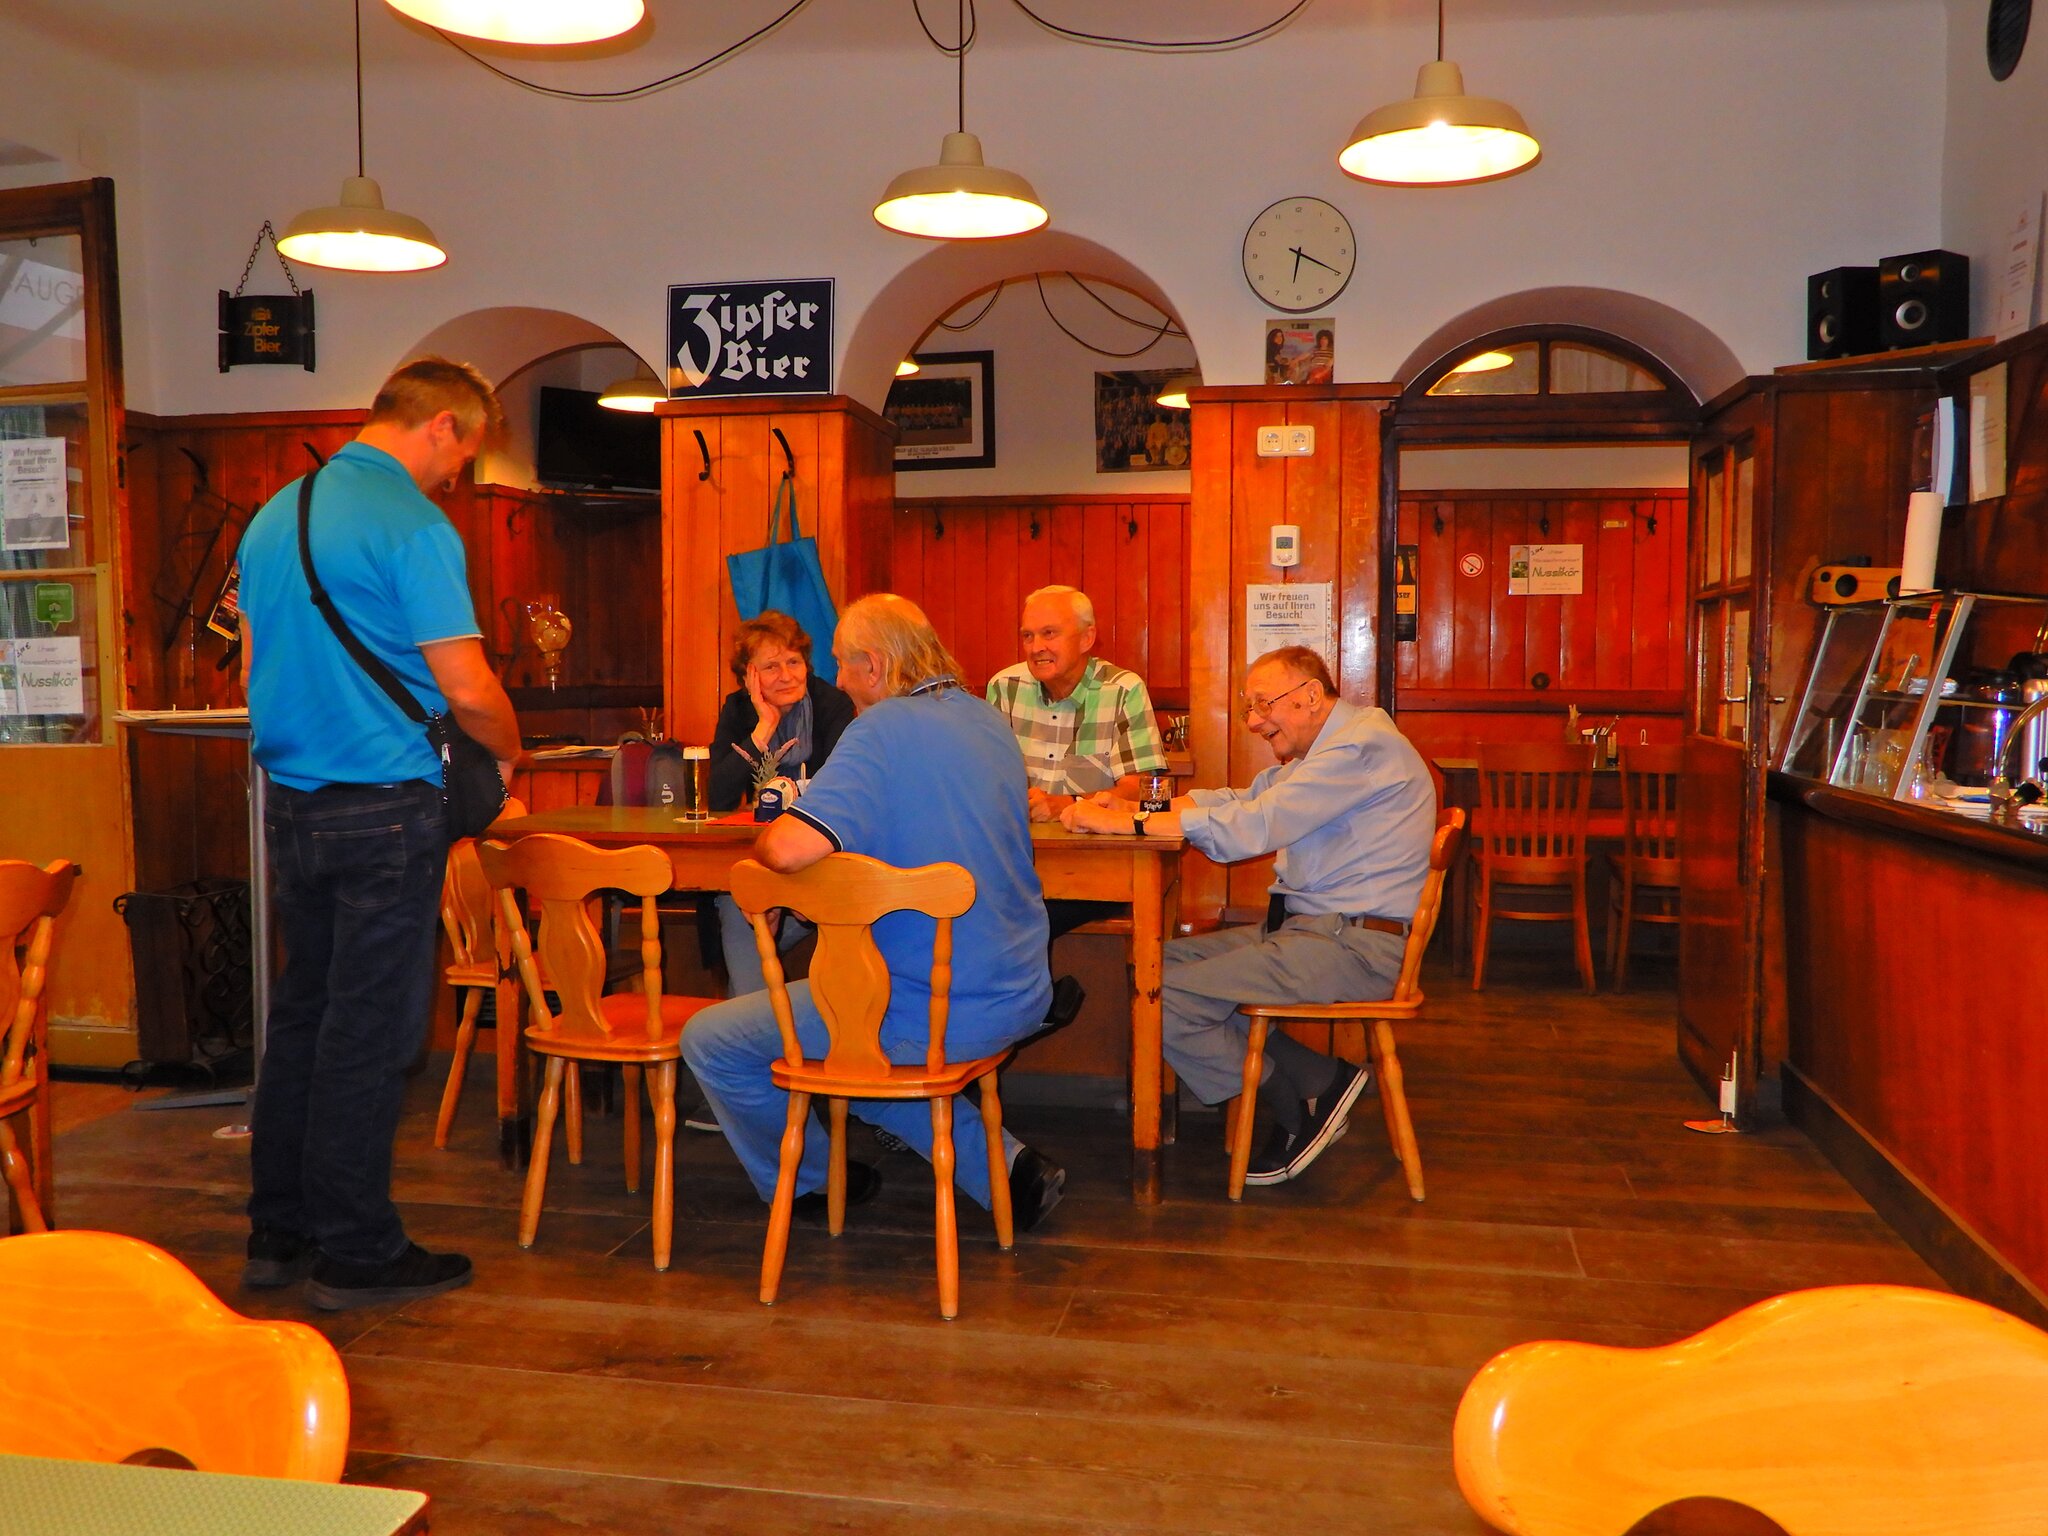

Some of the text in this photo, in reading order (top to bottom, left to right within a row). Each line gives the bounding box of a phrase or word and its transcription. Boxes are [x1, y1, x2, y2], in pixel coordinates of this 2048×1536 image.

[244, 322, 280, 337] Zipfer
[254, 337, 282, 353] Bier
[677, 290, 819, 388] Zipfer
[720, 339, 811, 381] Bier
[1532, 566, 1580, 577] Nusslikör
[1260, 592, 1309, 601] Wir freuen
[1253, 601, 1316, 610] uns auf Ihren
[1265, 610, 1303, 619] Besuch!
[21, 672, 78, 688] Nusslikör
